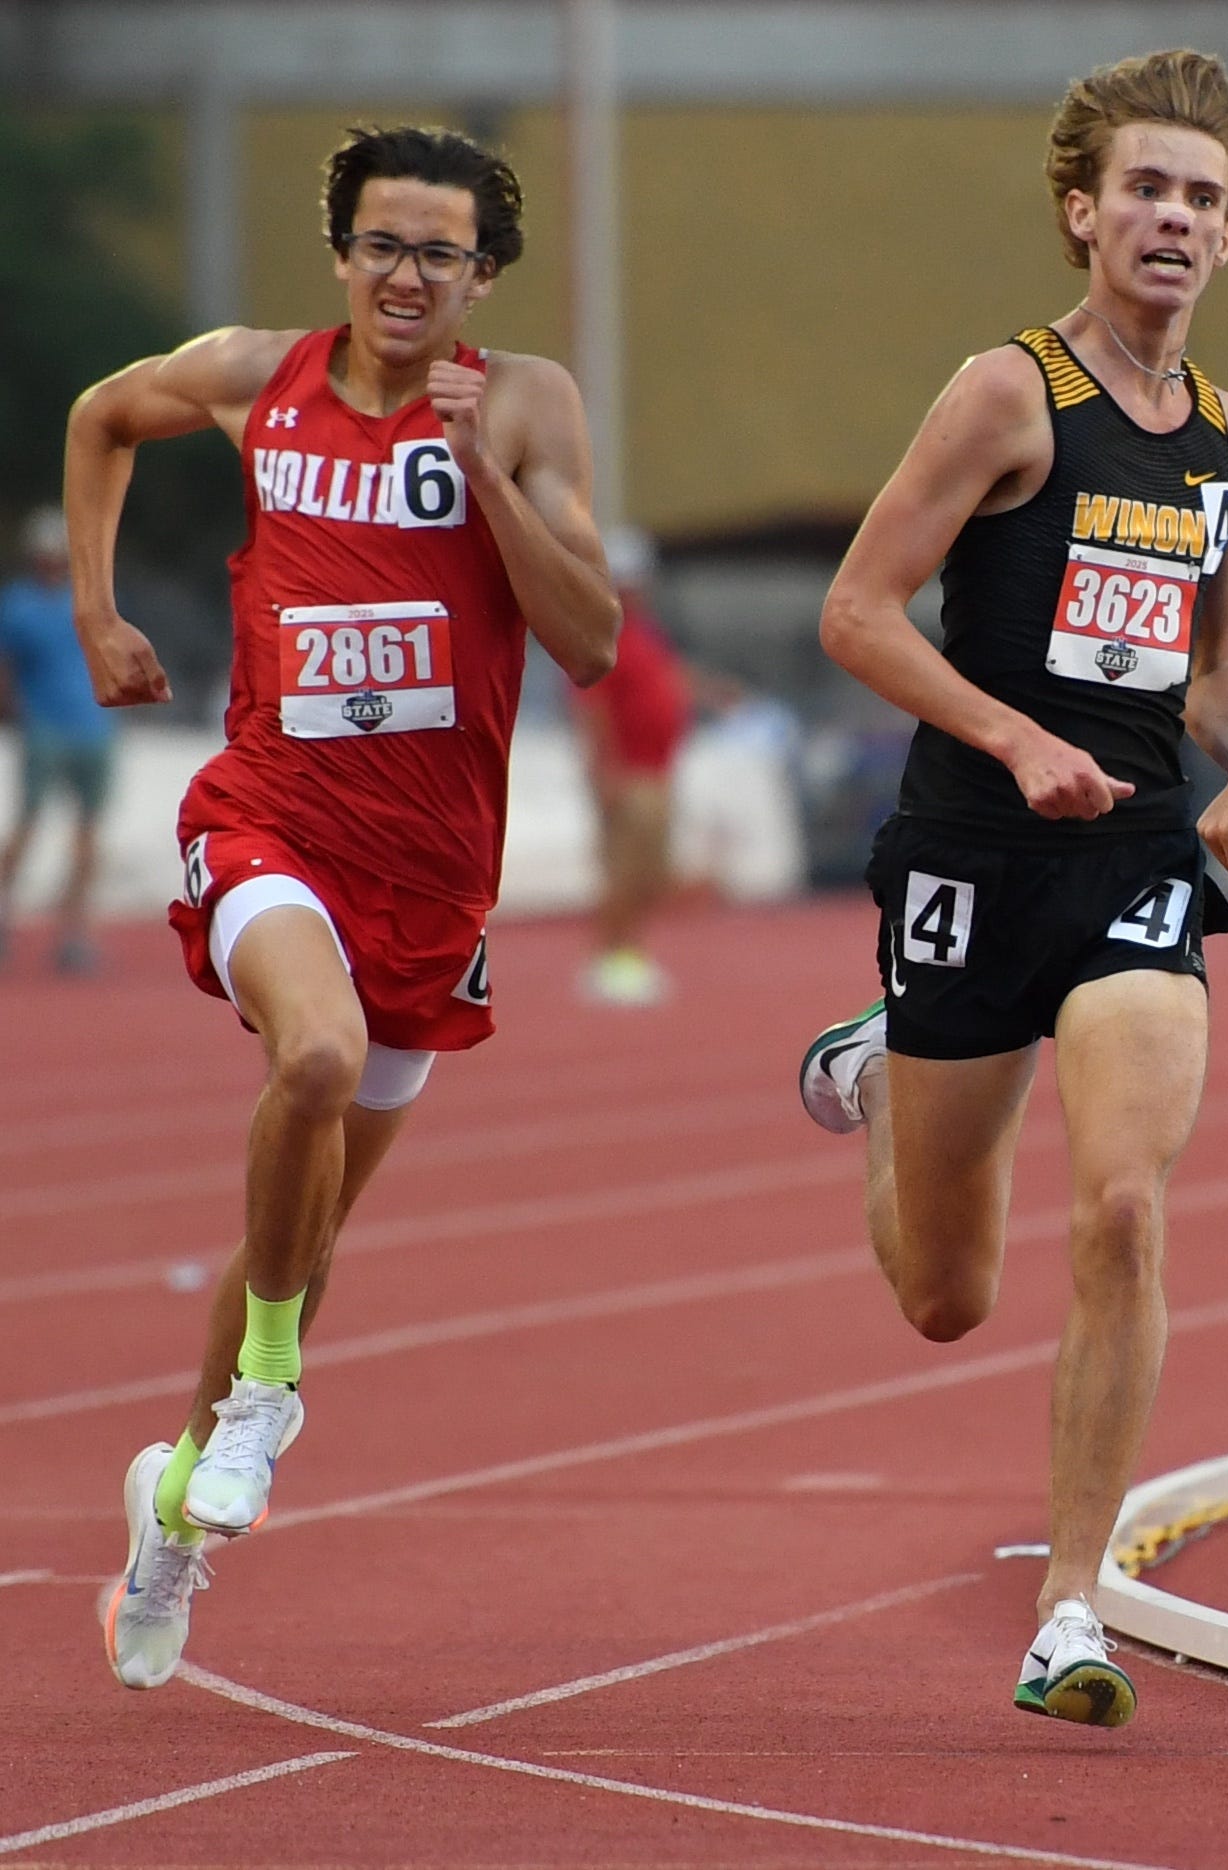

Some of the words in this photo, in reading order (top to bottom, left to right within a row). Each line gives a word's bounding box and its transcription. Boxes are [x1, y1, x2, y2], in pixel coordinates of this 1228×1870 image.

[404, 445, 455, 521] 6
[1072, 492, 1206, 558] WINON
[1065, 568, 1183, 644] 3623
[295, 624, 433, 688] 2861
[1095, 651, 1138, 670] STATE
[341, 703, 392, 718] STATE
[911, 883, 958, 962] 4
[1119, 881, 1175, 943] 4
